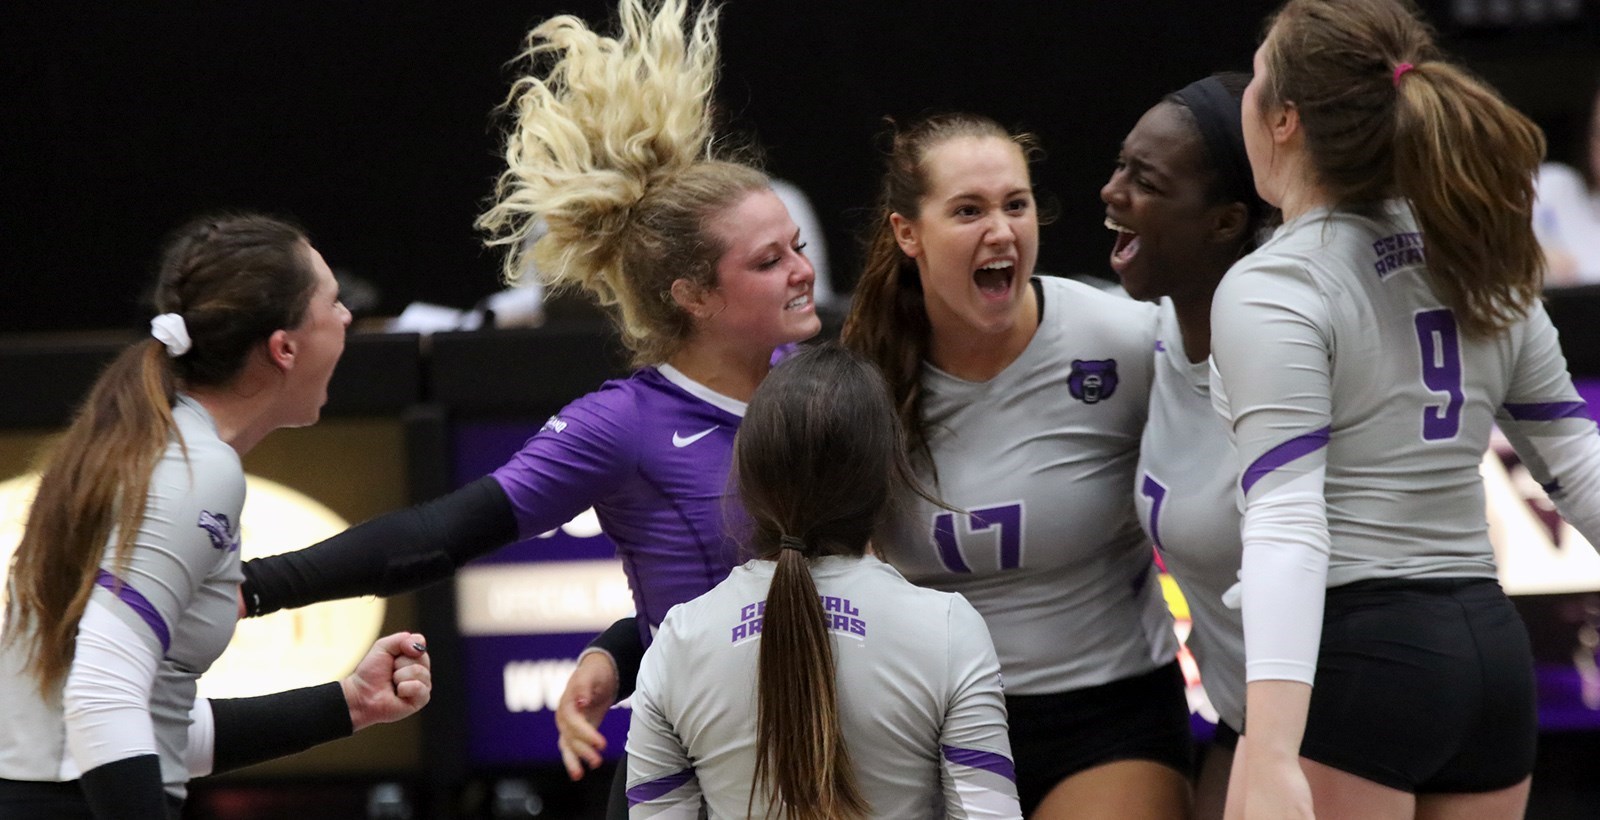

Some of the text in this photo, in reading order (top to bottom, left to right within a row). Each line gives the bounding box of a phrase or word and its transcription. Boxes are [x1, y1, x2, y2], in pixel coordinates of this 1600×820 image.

[1414, 308, 1466, 442] 9
[931, 500, 1025, 574] 17
[1140, 470, 1170, 551] 7
[740, 595, 859, 622] CEAL
